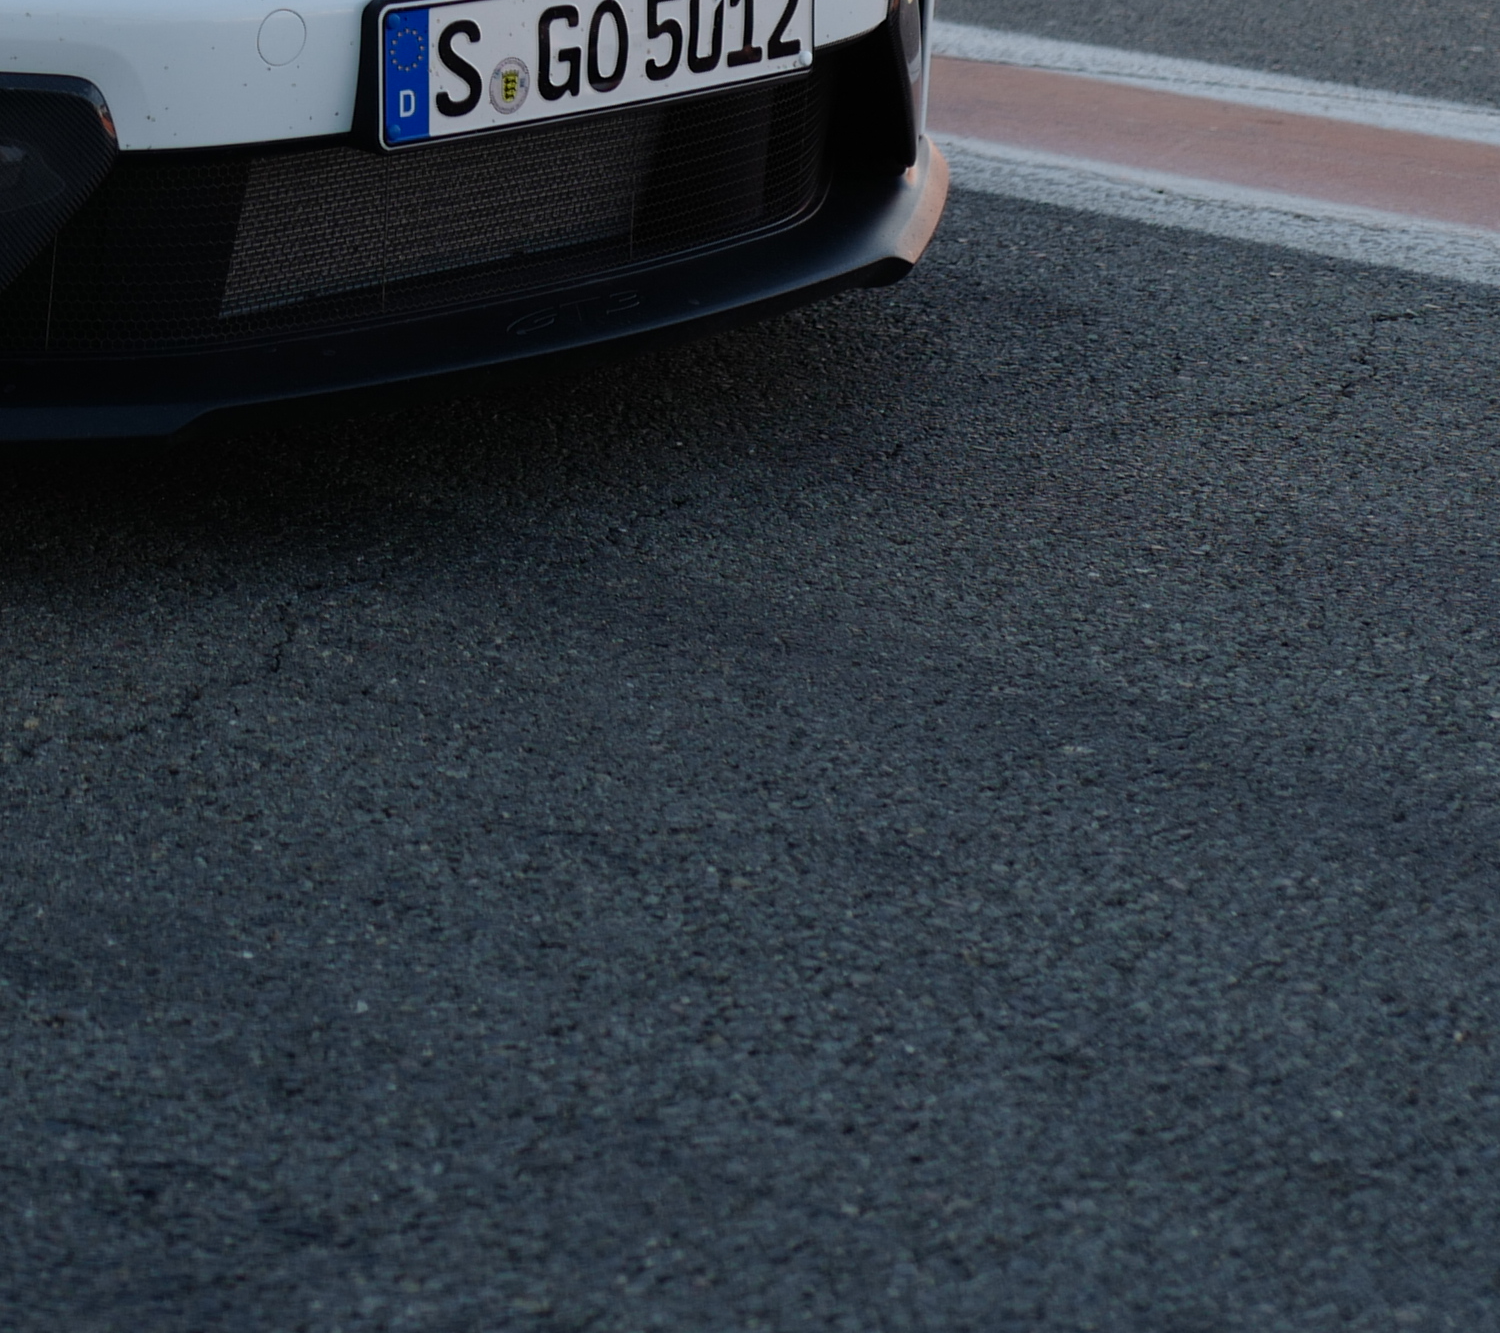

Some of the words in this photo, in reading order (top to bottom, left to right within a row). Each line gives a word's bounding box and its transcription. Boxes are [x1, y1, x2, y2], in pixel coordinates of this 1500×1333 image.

[399, 89, 416, 118] D
[435, 19, 482, 117] S
[505, 289, 641, 337] GT3
